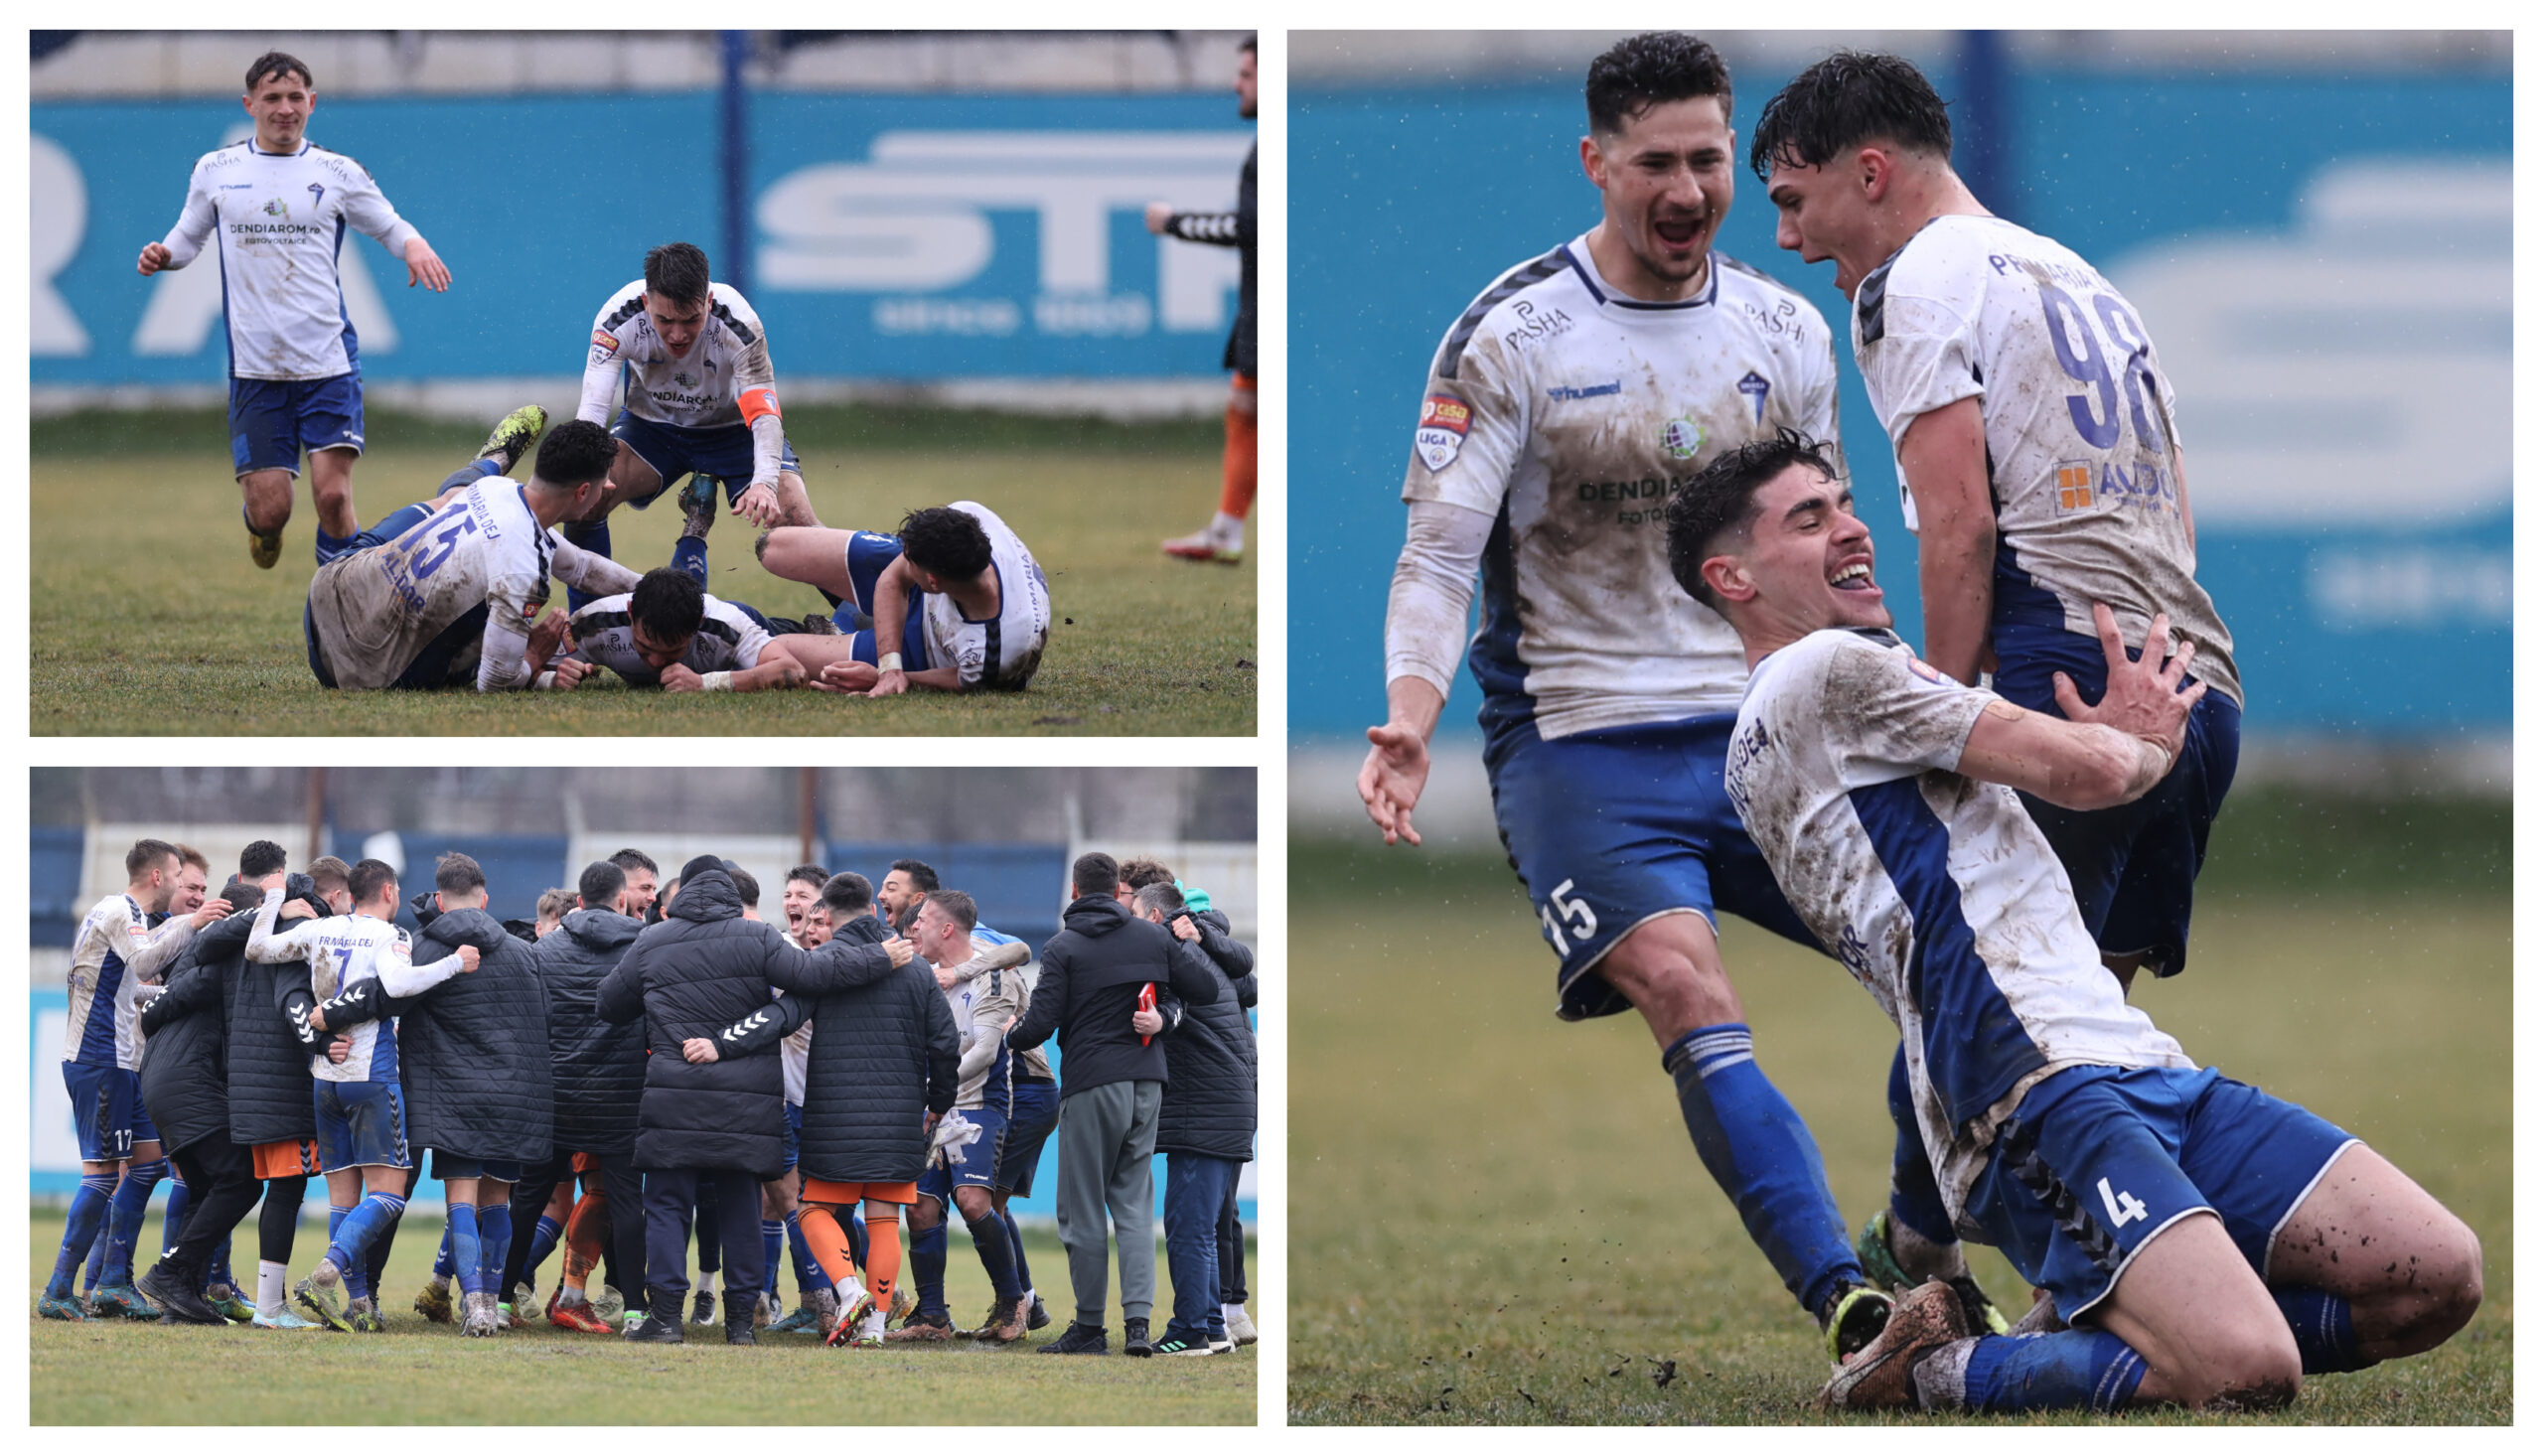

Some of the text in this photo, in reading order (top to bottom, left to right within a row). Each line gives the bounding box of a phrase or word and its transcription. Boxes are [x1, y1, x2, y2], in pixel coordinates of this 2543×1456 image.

[204, 156, 241, 173] PASHA
[317, 156, 349, 182] PASHA
[230, 223, 321, 234] DENDIAROM.ro
[1505, 308, 1572, 352] PASHA
[2039, 285, 2164, 455] 98
[1420, 432, 1447, 446] LIGA
[1578, 477, 1683, 502] DENDIA
[398, 503, 478, 580] 15
[481, 518, 502, 540] DEJ
[1542, 878, 1597, 956] 15
[333, 947, 353, 999] 7
[114, 1128, 133, 1152] 17
[2096, 1176, 2149, 1229] 4
